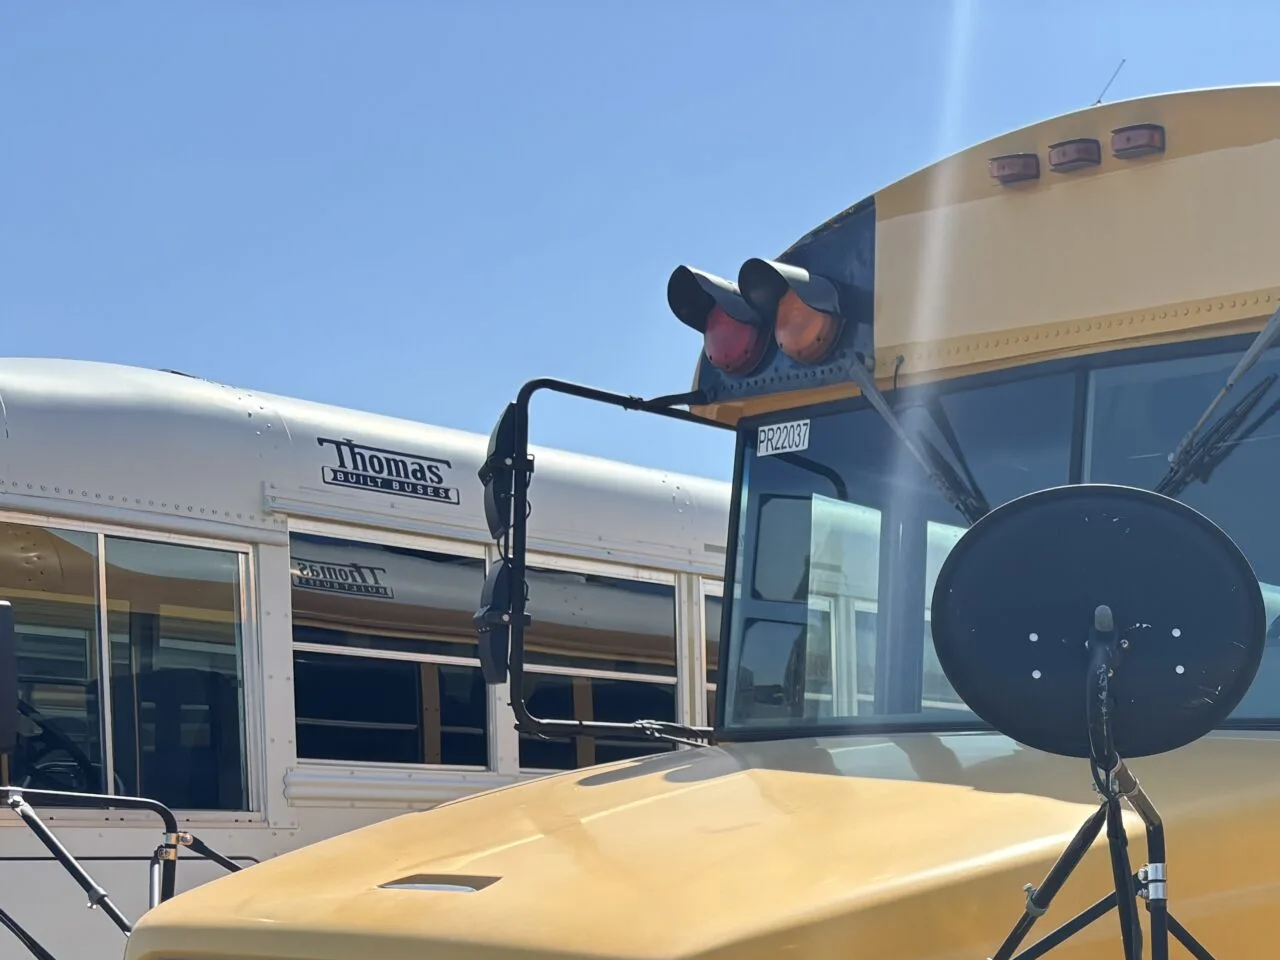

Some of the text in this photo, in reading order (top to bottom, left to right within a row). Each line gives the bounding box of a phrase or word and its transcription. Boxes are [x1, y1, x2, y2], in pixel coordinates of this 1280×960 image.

[758, 422, 809, 453] PR22037
[316, 436, 452, 486] Thomas
[335, 470, 446, 499] BUILT BUSES
